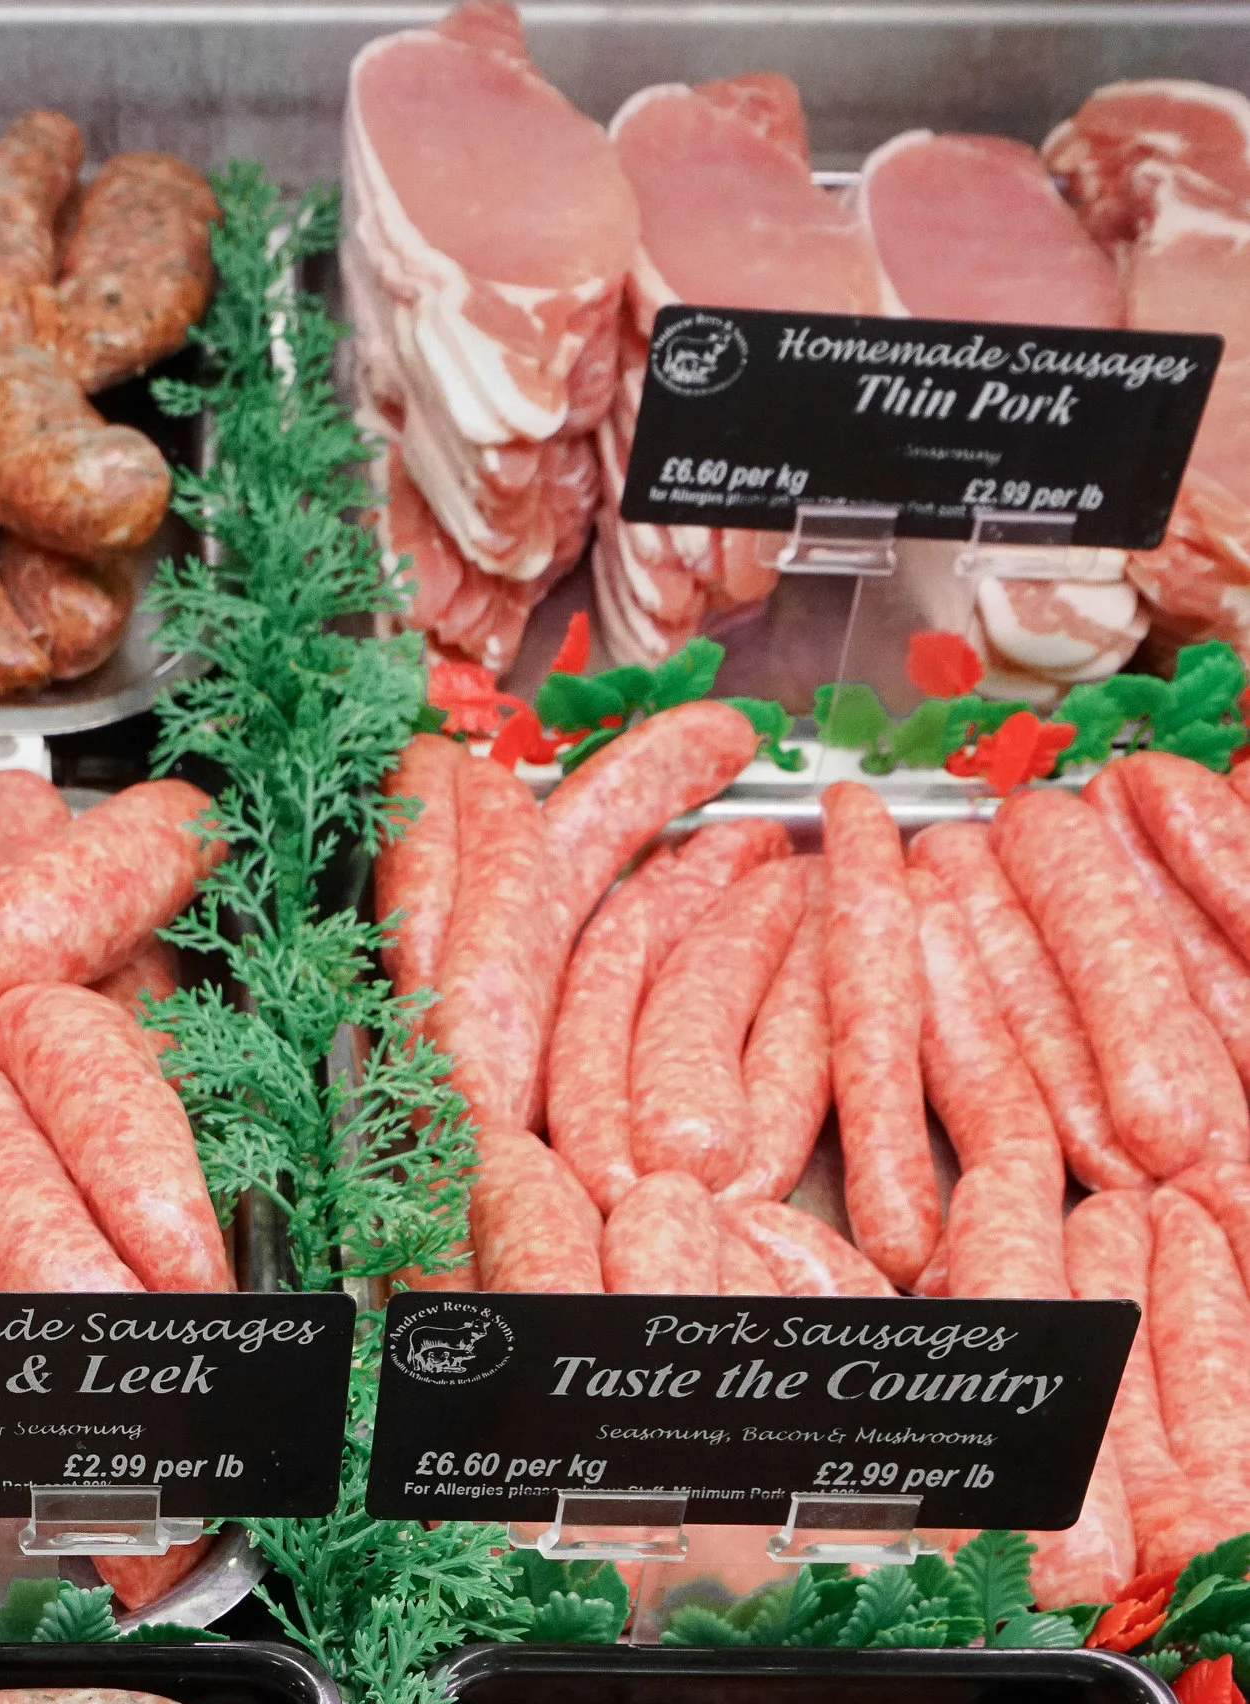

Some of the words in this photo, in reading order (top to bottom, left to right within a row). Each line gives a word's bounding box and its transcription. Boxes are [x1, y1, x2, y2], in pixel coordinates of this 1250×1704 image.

[779, 327, 1008, 370] Homemade
[1010, 342, 1197, 389] Sausages
[857, 375, 956, 418] Thin
[969, 381, 1078, 425] Pork
[658, 455, 729, 486] £6.60
[727, 465, 775, 491] per
[775, 462, 810, 496] kg
[963, 479, 1030, 511] £2.99
[1027, 487, 1077, 514] per
[1077, 484, 1103, 509] lb
[81, 1313, 325, 1353] Sausages
[390, 1304, 439, 1341] Andrew
[443, 1301, 478, 1313] Rees
[480, 1307, 491, 1318] &
[491, 1314, 515, 1342] Sons
[645, 1312, 770, 1346] Pork
[774, 1317, 1018, 1359] Sausages
[6, 1355, 52, 1393] &
[77, 1355, 217, 1393] Leek
[550, 1357, 699, 1397] Taste
[716, 1359, 808, 1399] the
[827, 1361, 1063, 1414] Country
[14, 1420, 147, 1440] Seasoning
[595, 1423, 731, 1443] Seasoning,
[742, 1427, 827, 1442] Bacon
[827, 1427, 846, 1443] &
[855, 1427, 998, 1446] Mushrooms
[63, 1454, 145, 1477] £2.99
[153, 1460, 208, 1483] per
[216, 1455, 243, 1477] lb
[415, 1451, 500, 1477] £6.60
[505, 1458, 562, 1483] per
[567, 1453, 608, 1484] kg
[813, 1462, 898, 1486] £2.99
[900, 1469, 960, 1492] per
[964, 1464, 994, 1488] lb
[404, 1482, 430, 1495] For
[434, 1483, 503, 1499] Allergies
[750, 1487, 786, 1500] Pork
